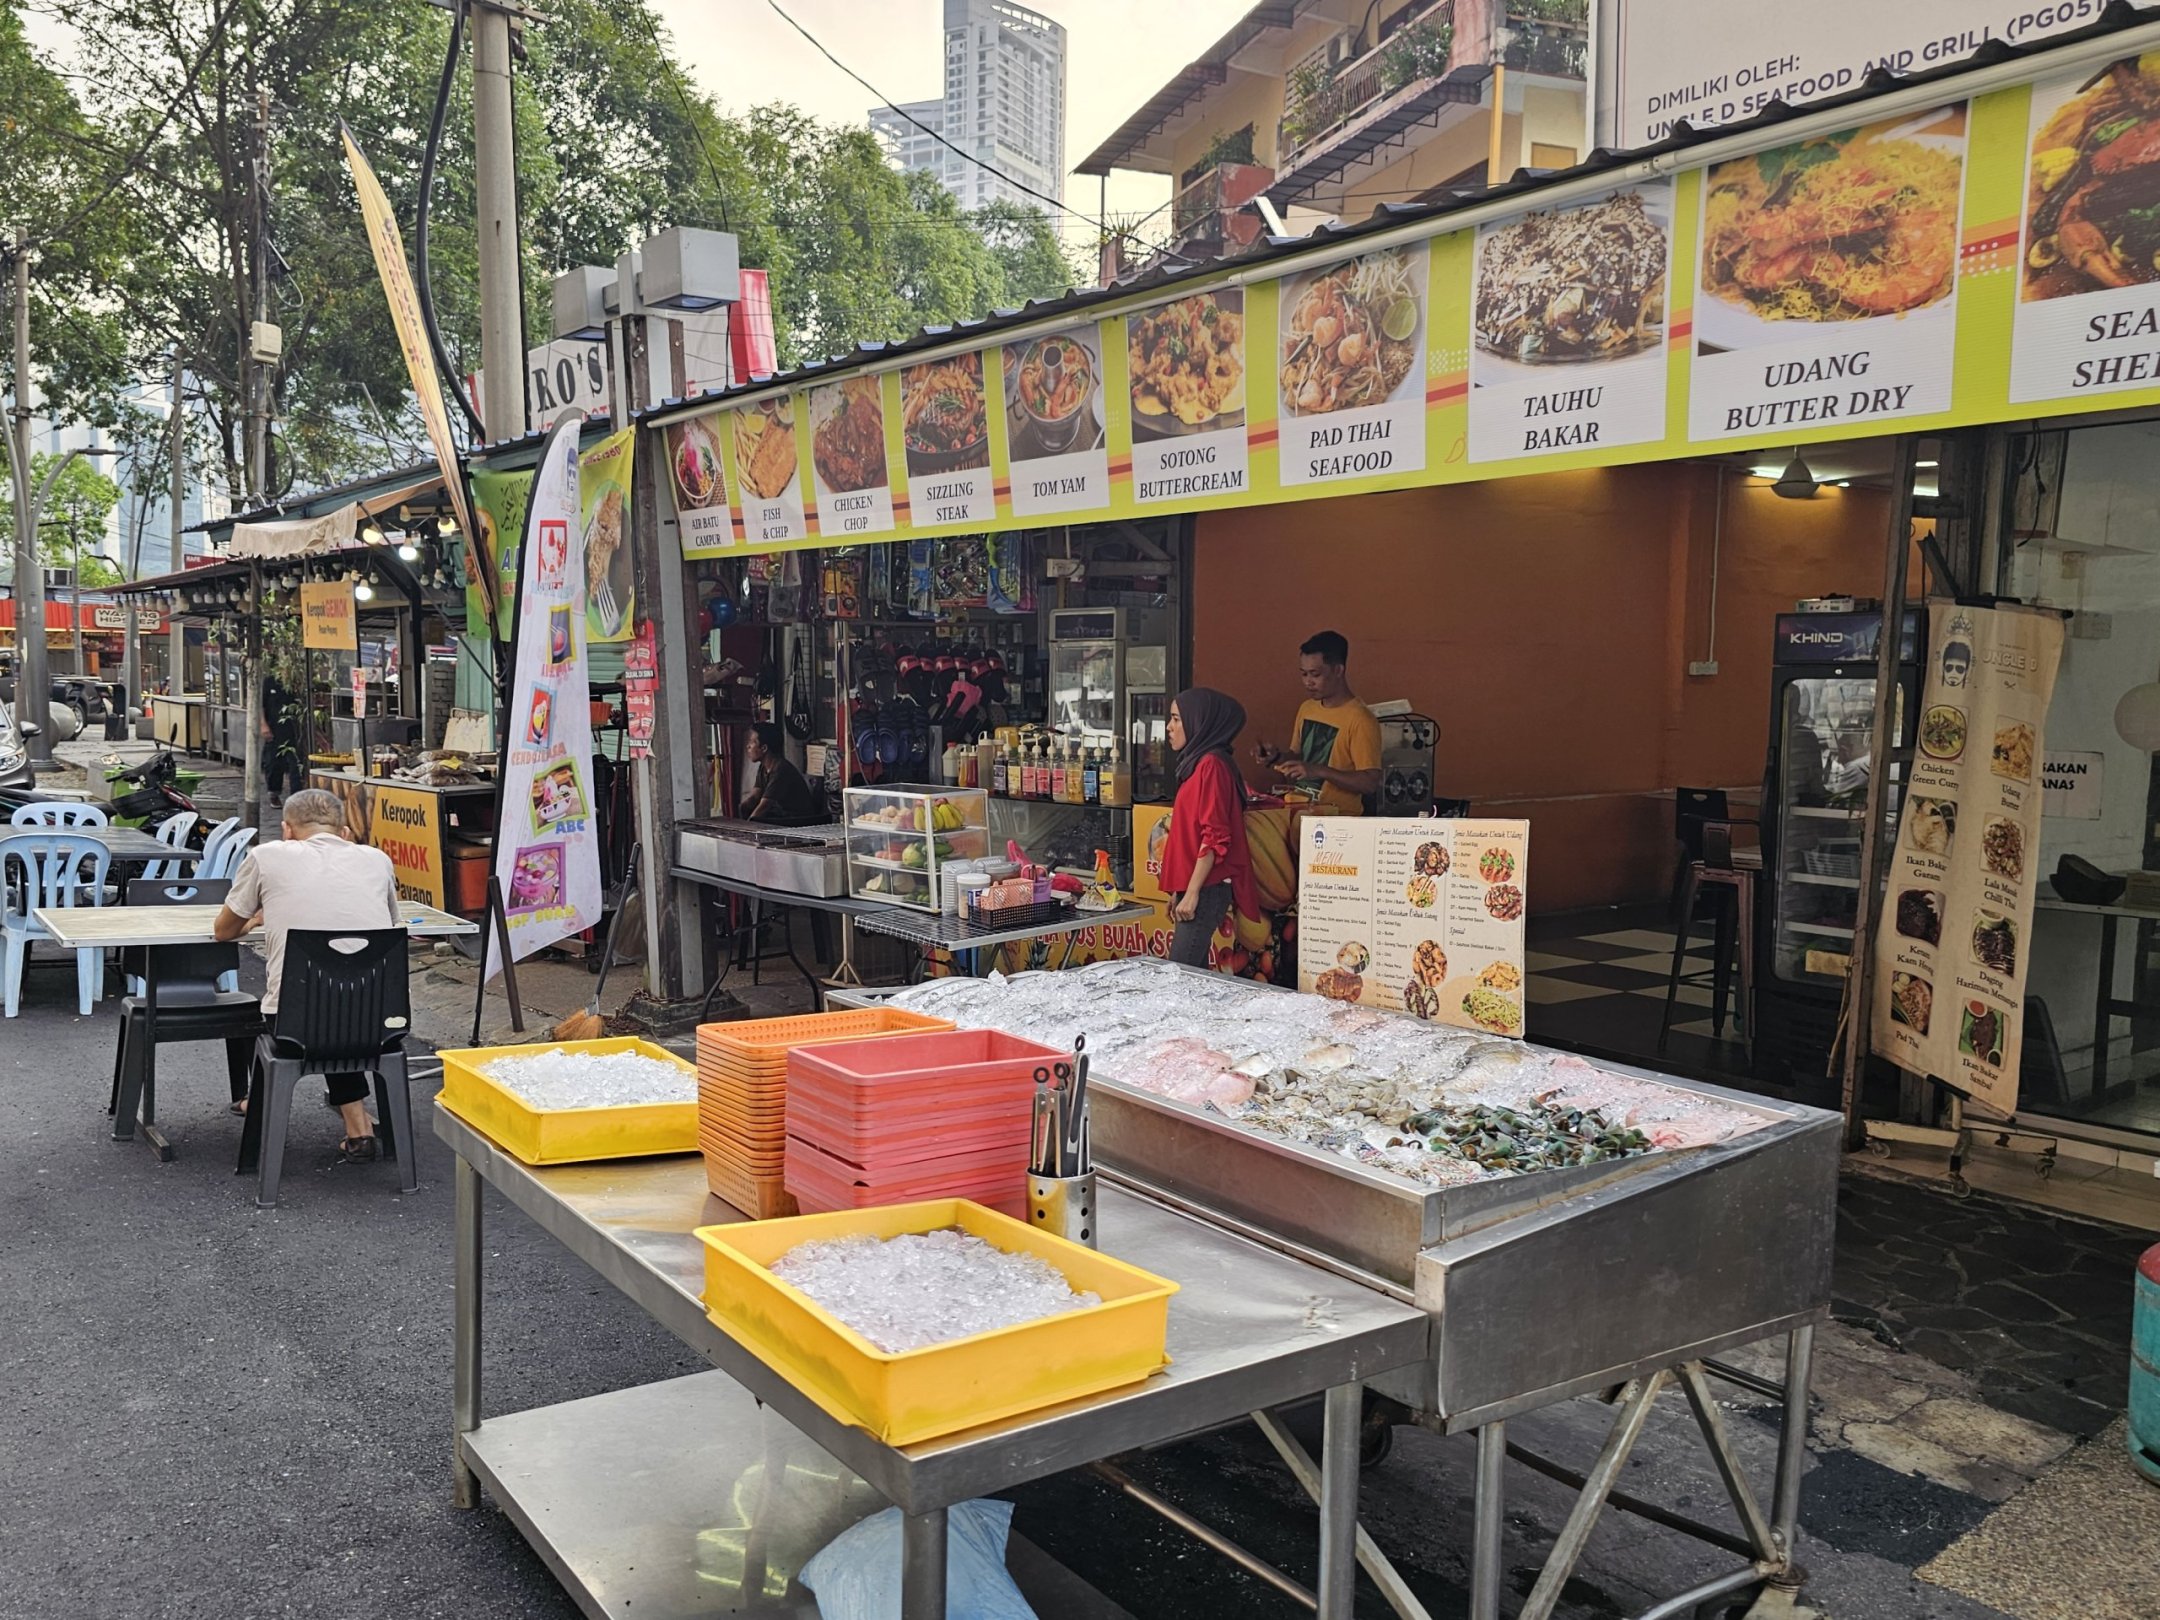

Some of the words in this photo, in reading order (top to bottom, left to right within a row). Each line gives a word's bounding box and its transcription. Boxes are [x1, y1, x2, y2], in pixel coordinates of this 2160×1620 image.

[1647, 107, 1714, 140] UNE
[1721, 102, 1735, 119] D
[1860, 50, 1914, 81] AND
[1922, 26, 1989, 61] GRILL
[1648, 76, 1728, 114] DIMILIKI
[1735, 55, 1800, 87] OLEH:
[1764, 351, 1870, 388] UDANG
[1524, 386, 1604, 418] TAUHU
[1724, 396, 1838, 431] BUTTER
[1848, 384, 1913, 416] DRY
[1309, 430, 1342, 449] PAD
[1347, 420, 1392, 444] THAI
[1523, 422, 1599, 450] BAKAR
[1160, 446, 1216, 470] SOTONG
[1309, 450, 1392, 478] SEAFOOD
[926, 481, 974, 500] SIZZLING
[1033, 480, 1058, 497] TOM
[1060, 476, 1085, 494] YAM
[1139, 470, 1243, 499] BUTTERCREAM
[834, 495, 873, 512] CHICKEN
[763, 508, 781, 521] FISH
[936, 505, 969, 521] STEAK
[691, 519, 702, 530] AIR
[702, 516, 719, 529] BATU
[844, 517, 868, 531] CHOP
[695, 534, 721, 547] CAMPUR
[763, 528, 769, 540] &
[770, 526, 789, 539] CHIP
[1790, 632, 1843, 644] KHIND
[1921, 763, 1955, 776] Chicken
[1912, 774, 1936, 786] Green
[1938, 778, 1960, 792] Curry
[2002, 784, 2021, 800] Udang
[381, 798, 426, 829] Keropok
[555, 819, 586, 835] ABC
[381, 838, 430, 872] GEMOK
[1313, 851, 1343, 865] MENU
[1906, 856, 1925, 867] Ikan
[1312, 865, 1357, 876] RESTAURANT
[1913, 869, 1941, 881] Garam
[1897, 954, 1917, 966] Kam
[1979, 970, 2004, 990] Daging
[1962, 1058, 1979, 1073] Ikan
[1979, 1065, 1999, 1082] Bakar
[1969, 1073, 1993, 1091] Sambal
